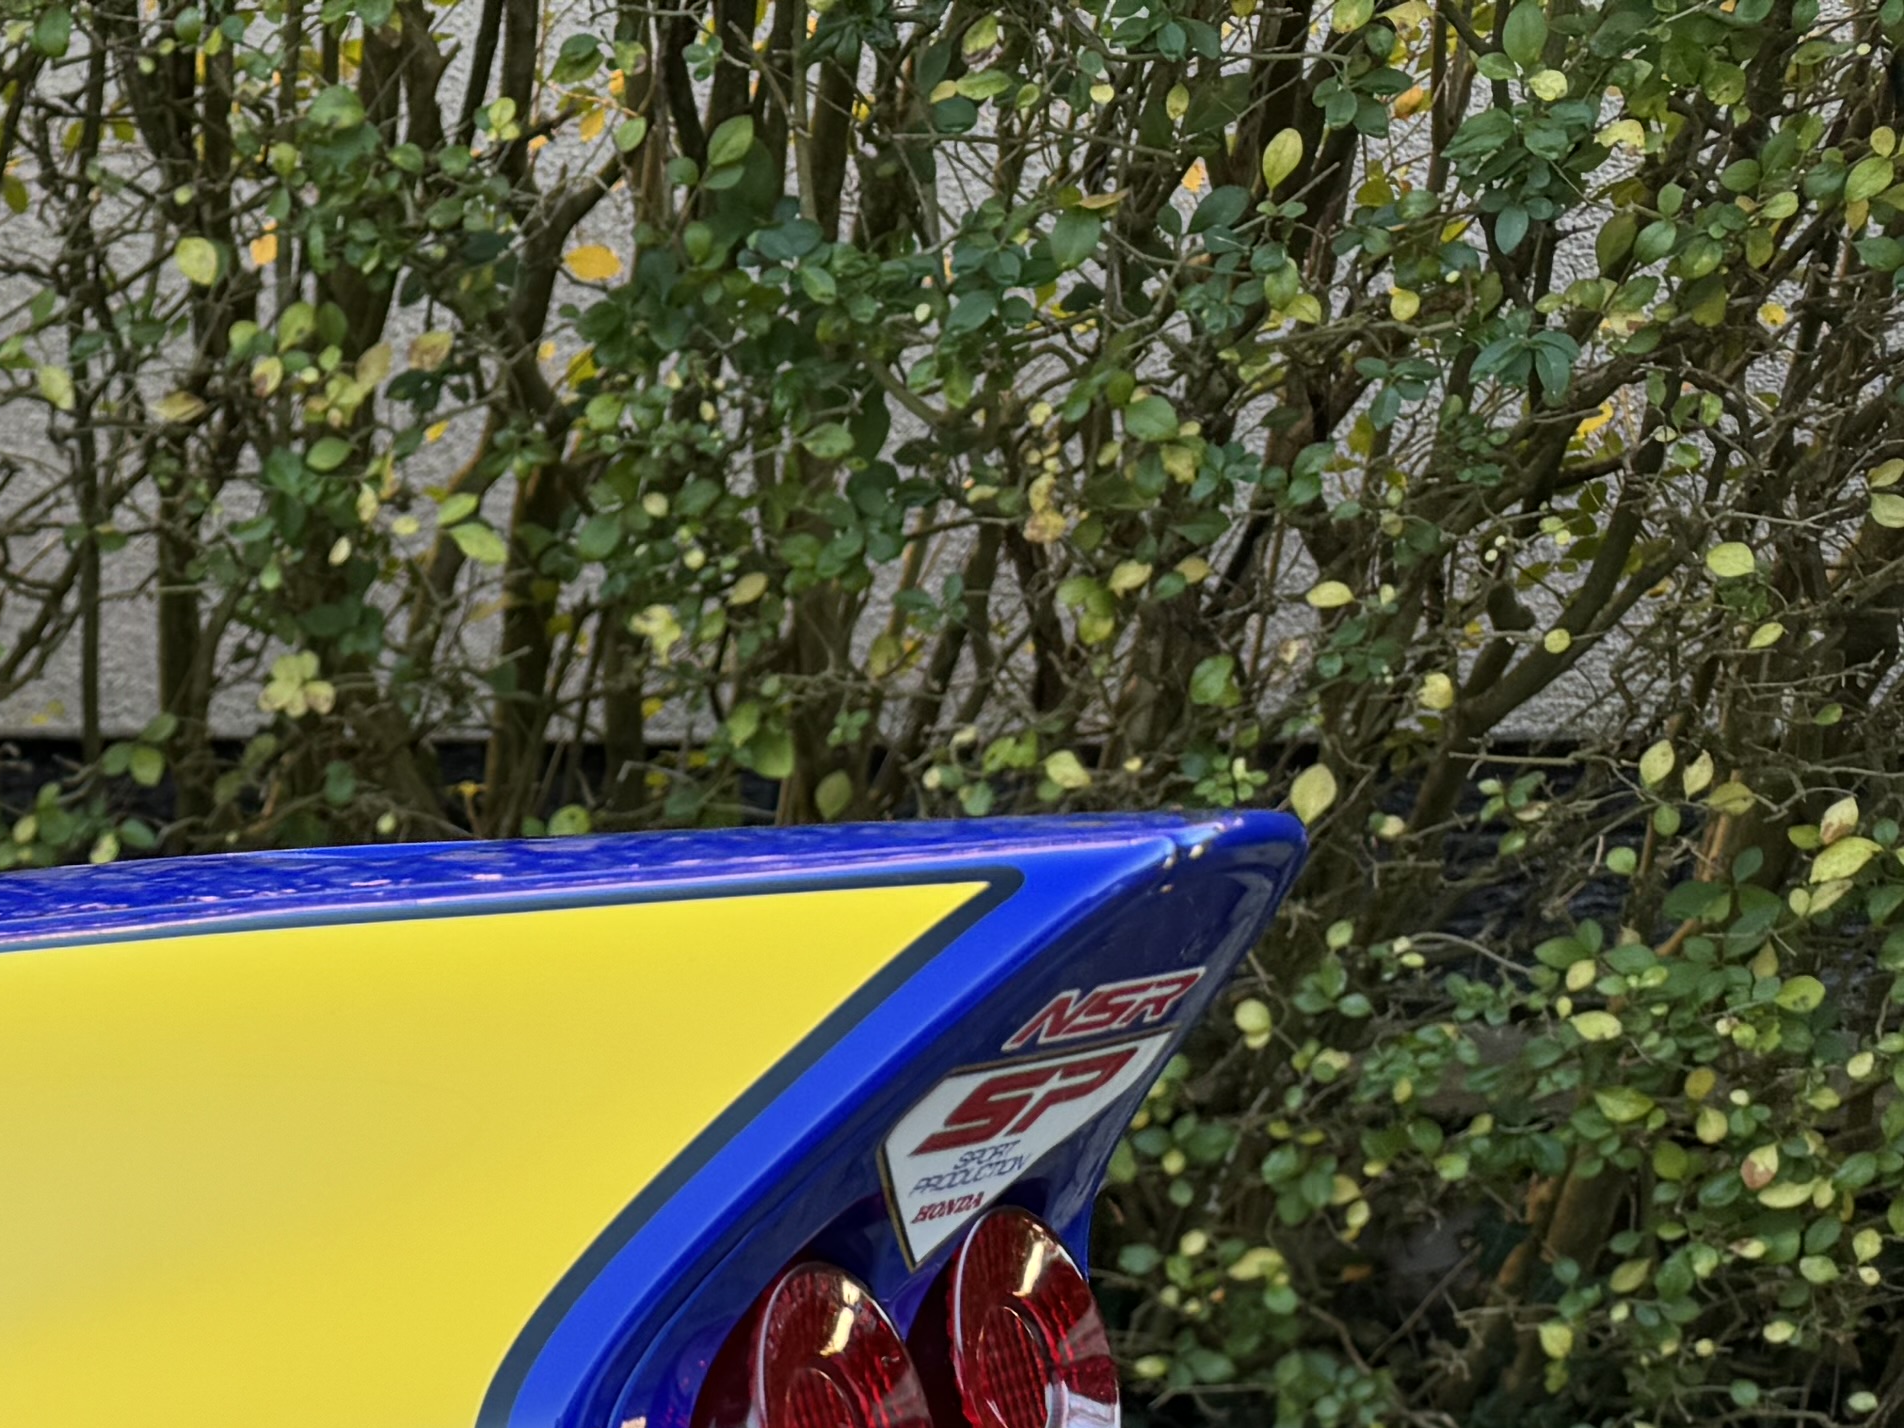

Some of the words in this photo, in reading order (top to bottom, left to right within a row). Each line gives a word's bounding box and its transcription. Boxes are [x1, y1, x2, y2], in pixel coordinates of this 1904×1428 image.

[1002, 966, 1206, 1053] NSR
[910, 1046, 1139, 1157] SP
[908, 1153, 1031, 1197] PRODUCTION
[953, 1139, 1021, 1170] SPORT
[911, 1190, 984, 1224] HONDA
